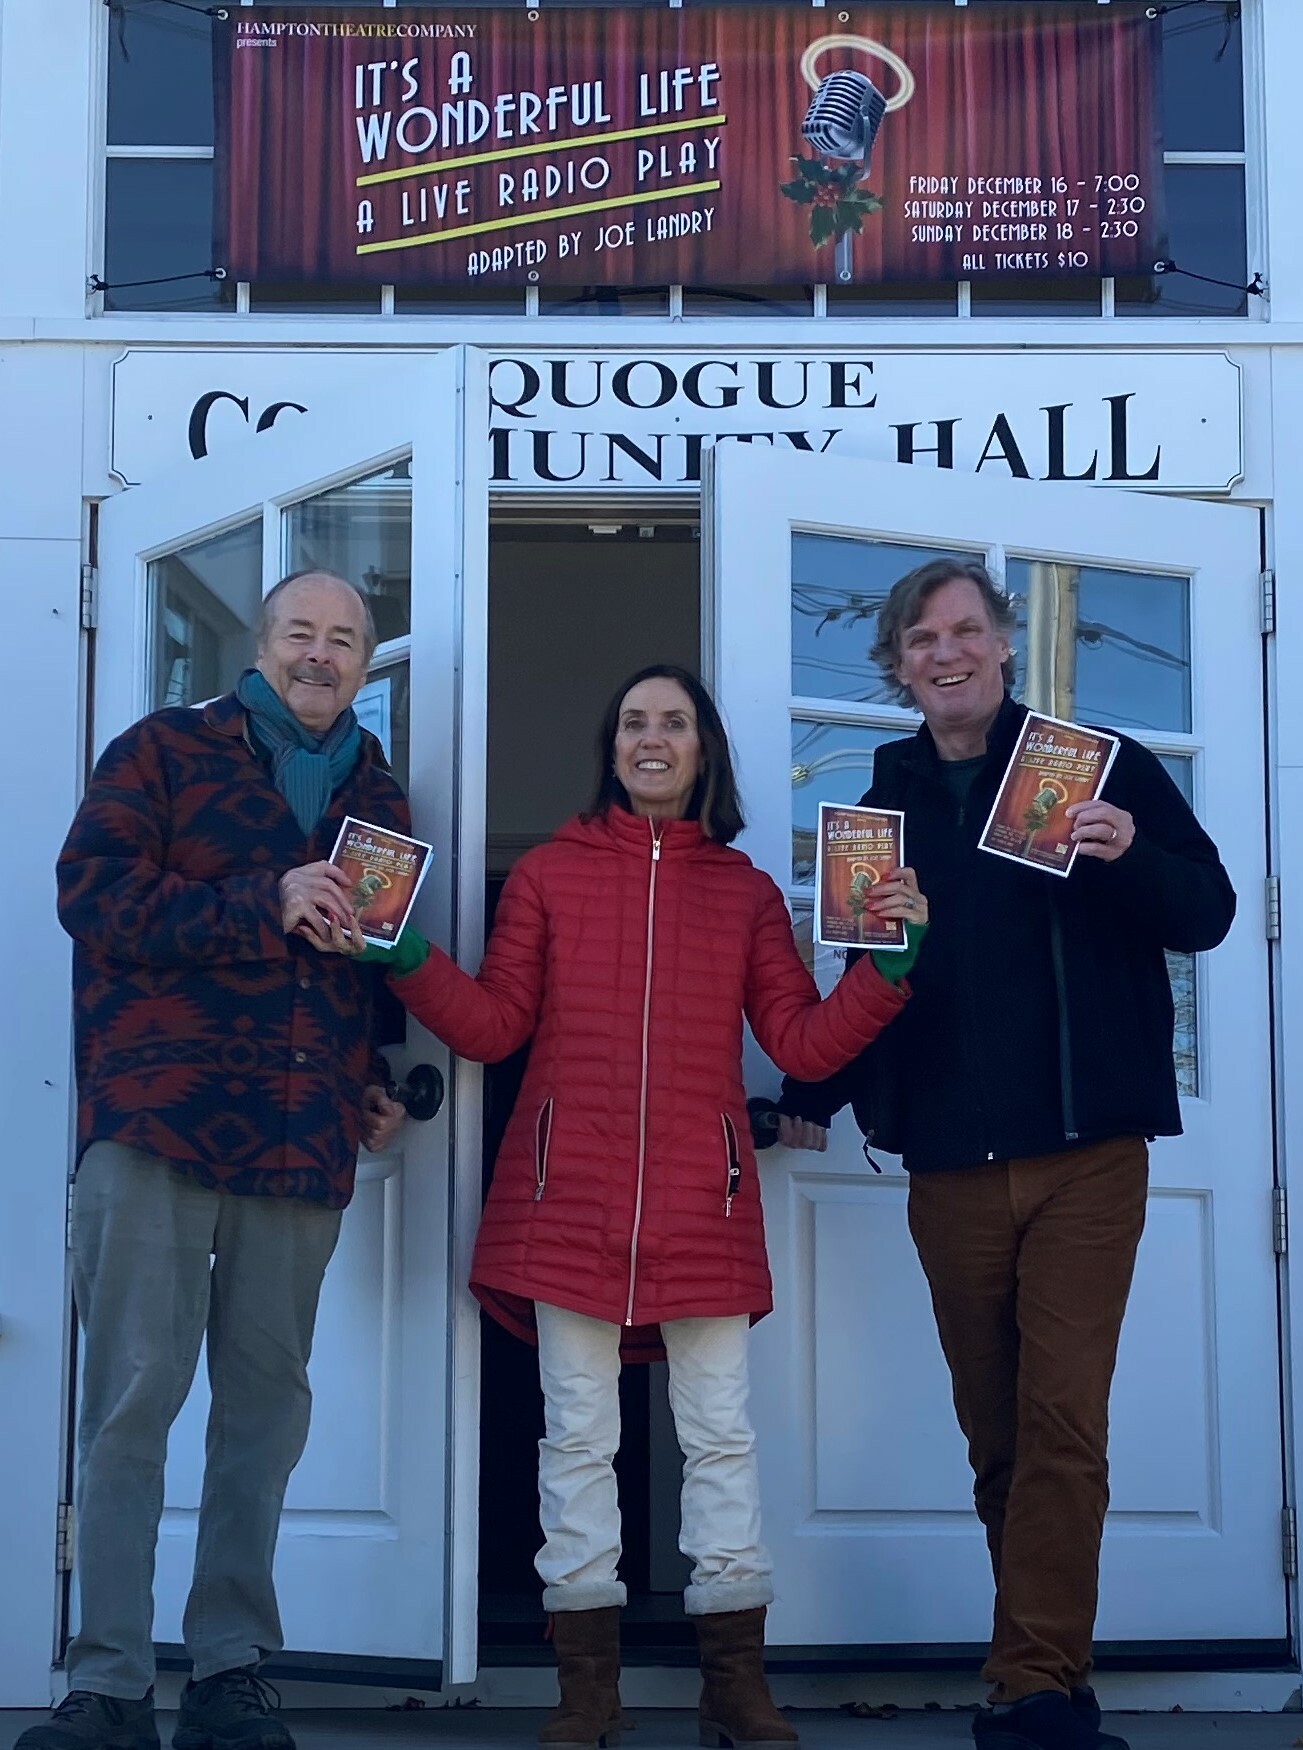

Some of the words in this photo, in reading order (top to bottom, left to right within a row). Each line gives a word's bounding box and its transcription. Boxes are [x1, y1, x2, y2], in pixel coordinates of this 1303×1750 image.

[237, 37, 277, 48] presents
[355, 57, 419, 108] IT'S
[447, 51, 473, 95] A
[356, 80, 610, 163] WONDERFUL
[640, 63, 720, 116] LIFE
[356, 200, 374, 233] A
[402, 180, 471, 226] LIVE
[499, 157, 610, 207] RADIO
[638, 137, 721, 181] PLAY
[904, 200, 974, 219] SATURDAY
[982, 200, 1057, 218] DECEMBER
[1066, 199, 1080, 217] 17
[1107, 197, 1145, 216] 2:30
[909, 176, 959, 195] FRIDAY
[967, 176, 1042, 195] DECEMBER
[1050, 176, 1068, 194] 16
[1094, 174, 1140, 193] 7:00
[467, 240, 547, 276] ADAPTED
[559, 231, 582, 258] BY
[594, 222, 635, 252] JOE
[647, 207, 716, 242] LANDRY
[911, 224, 963, 243] SUNDAY
[973, 223, 1048, 242] DECEMBER
[1056, 222, 1074, 241] 18
[1100, 220, 1139, 239] 2:30
[962, 253, 986, 270] ALL
[995, 252, 1049, 269] TICKETS
[1057, 251, 1089, 268] $10
[489, 360, 877, 420] QUOGUE
[891, 393, 1161, 481] HALL
